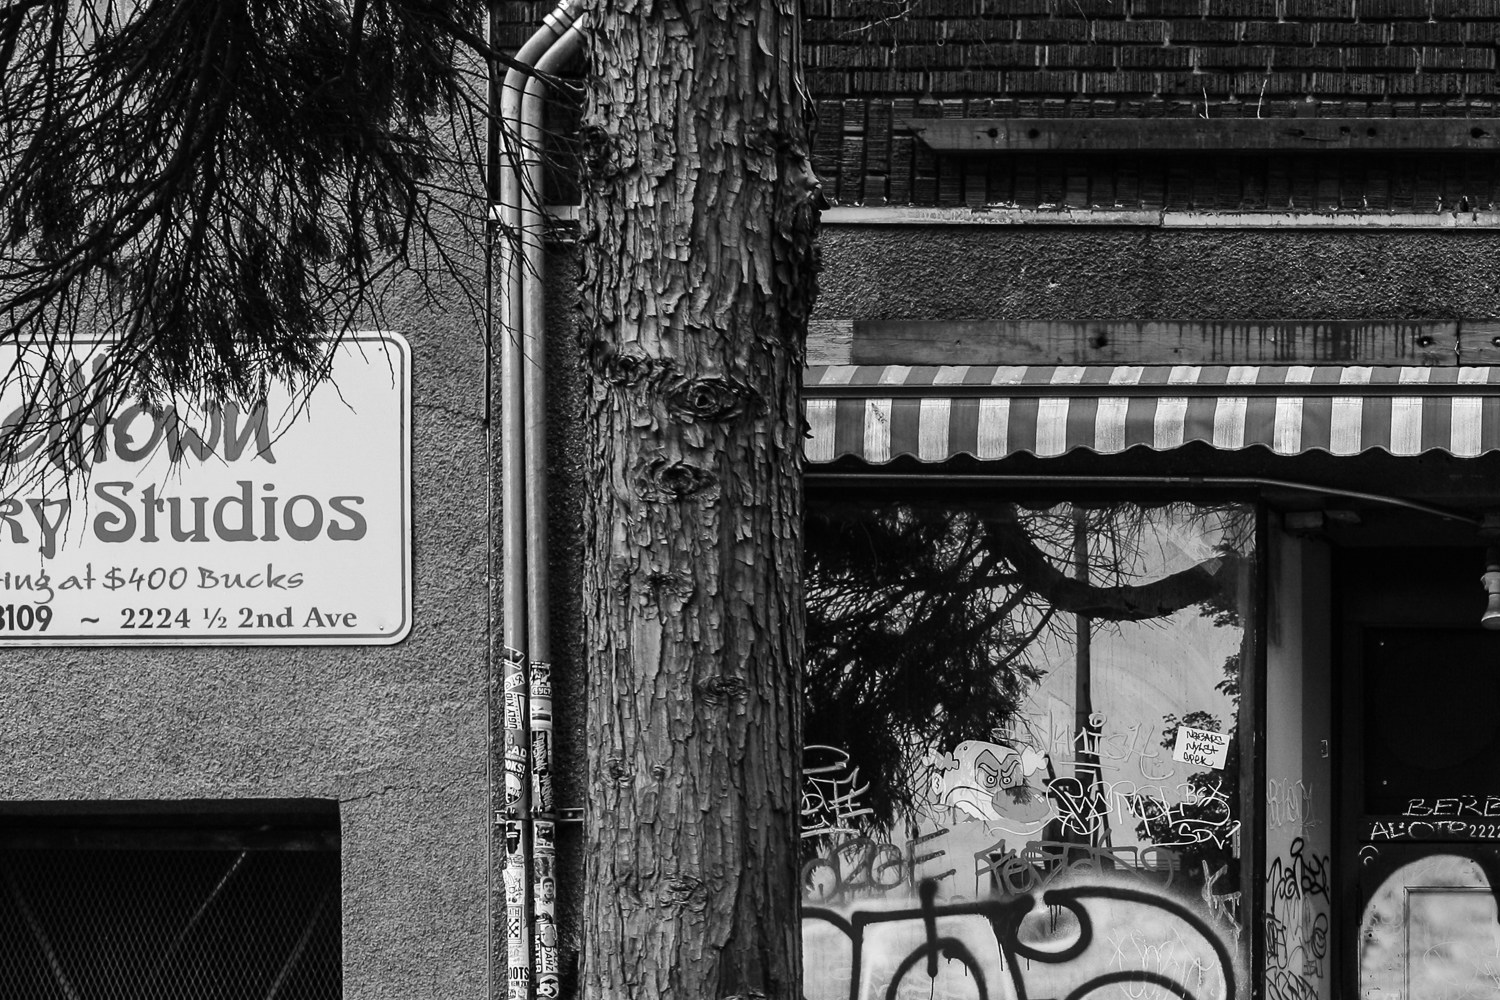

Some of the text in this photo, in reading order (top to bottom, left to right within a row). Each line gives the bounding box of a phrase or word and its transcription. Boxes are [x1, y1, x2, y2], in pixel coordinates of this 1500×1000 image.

[93, 480, 368, 543] Studios
[57, 563, 97, 591] at
[103, 566, 188, 592] $400
[197, 564, 304, 591] Bucks
[120, 608, 191, 630] 2224
[238, 606, 293, 629] 2nd
[303, 607, 358, 629] Ave
